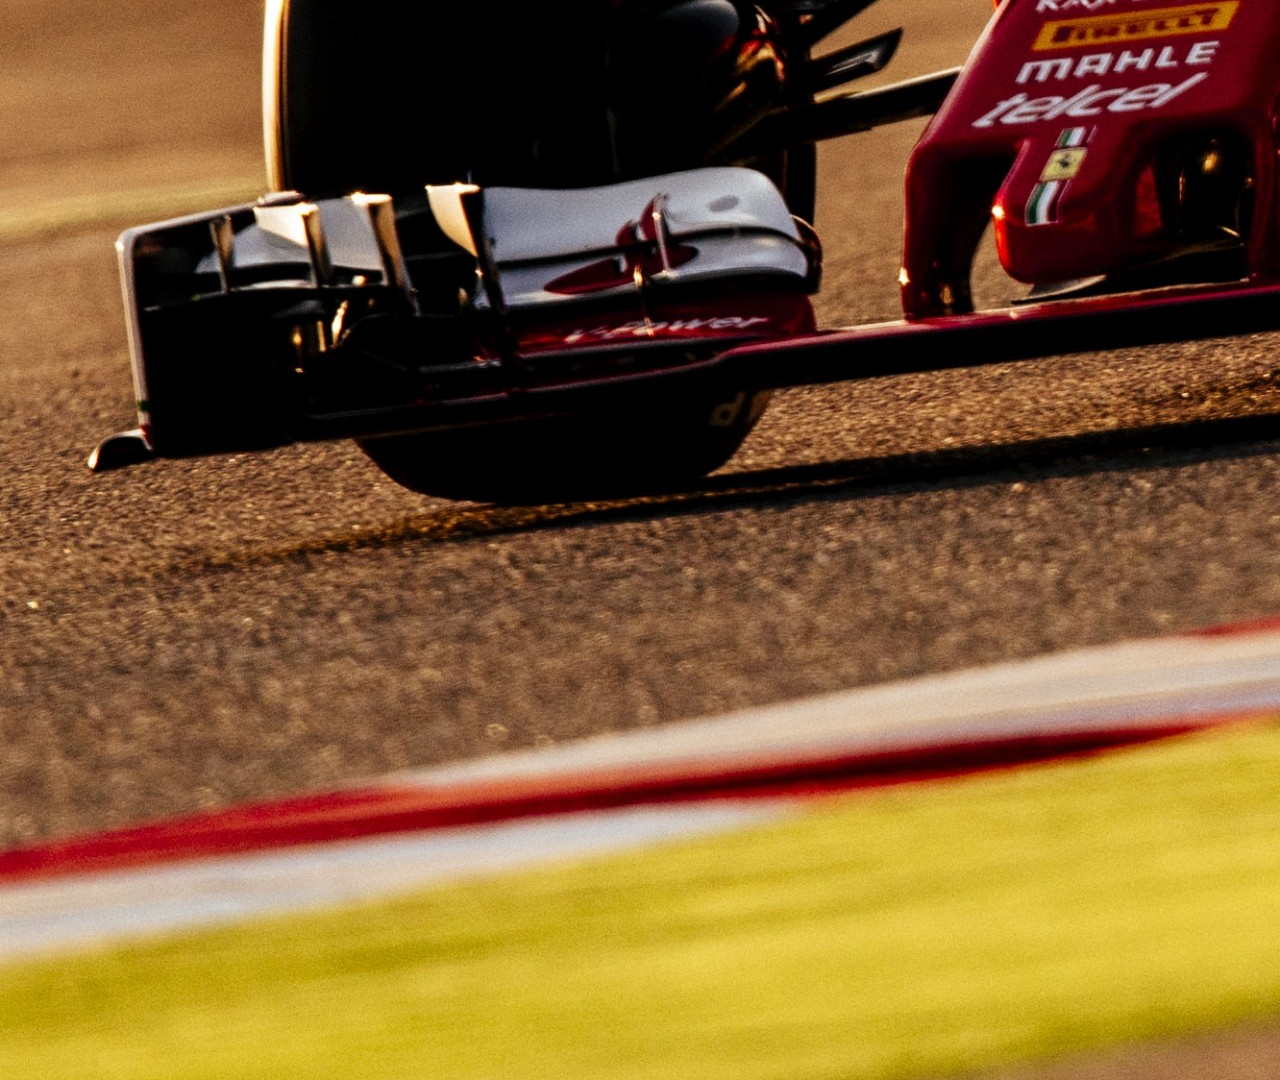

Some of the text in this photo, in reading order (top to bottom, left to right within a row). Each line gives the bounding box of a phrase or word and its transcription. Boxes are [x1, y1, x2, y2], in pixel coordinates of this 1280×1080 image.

[1051, 7, 1220, 43] PIRELLI
[1015, 40, 1220, 85] MAHLE
[971, 71, 1209, 128] telcel
